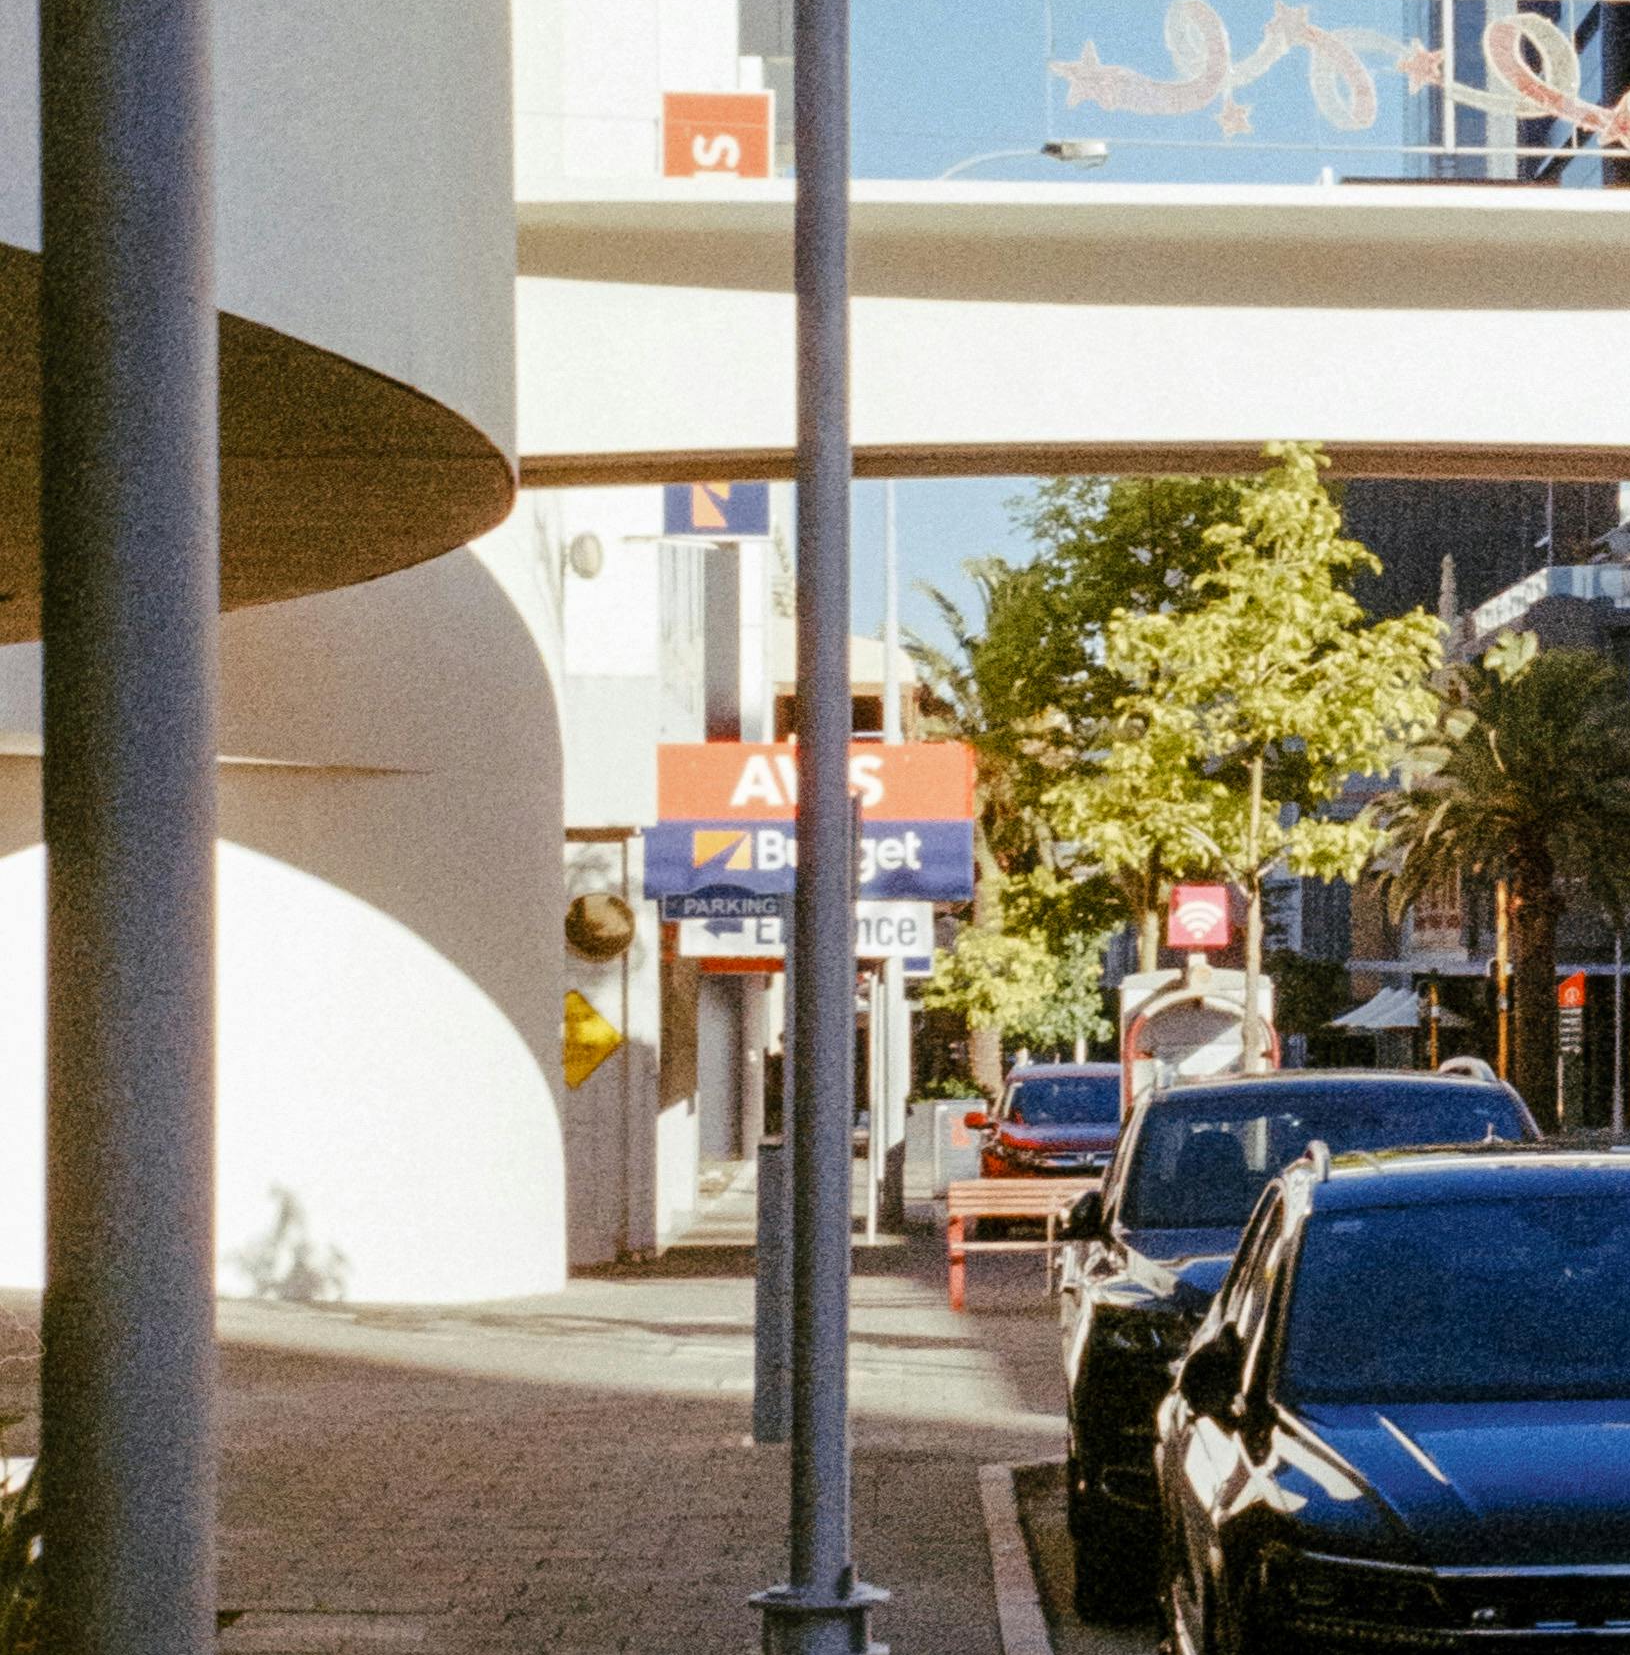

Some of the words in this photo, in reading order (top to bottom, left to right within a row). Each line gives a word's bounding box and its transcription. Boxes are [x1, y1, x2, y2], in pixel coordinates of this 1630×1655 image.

[729, 754, 885, 808] AS
[756, 829, 922, 884] Bget
[684, 897, 778, 915] PARKING
[755, 916, 917, 946] Ence
